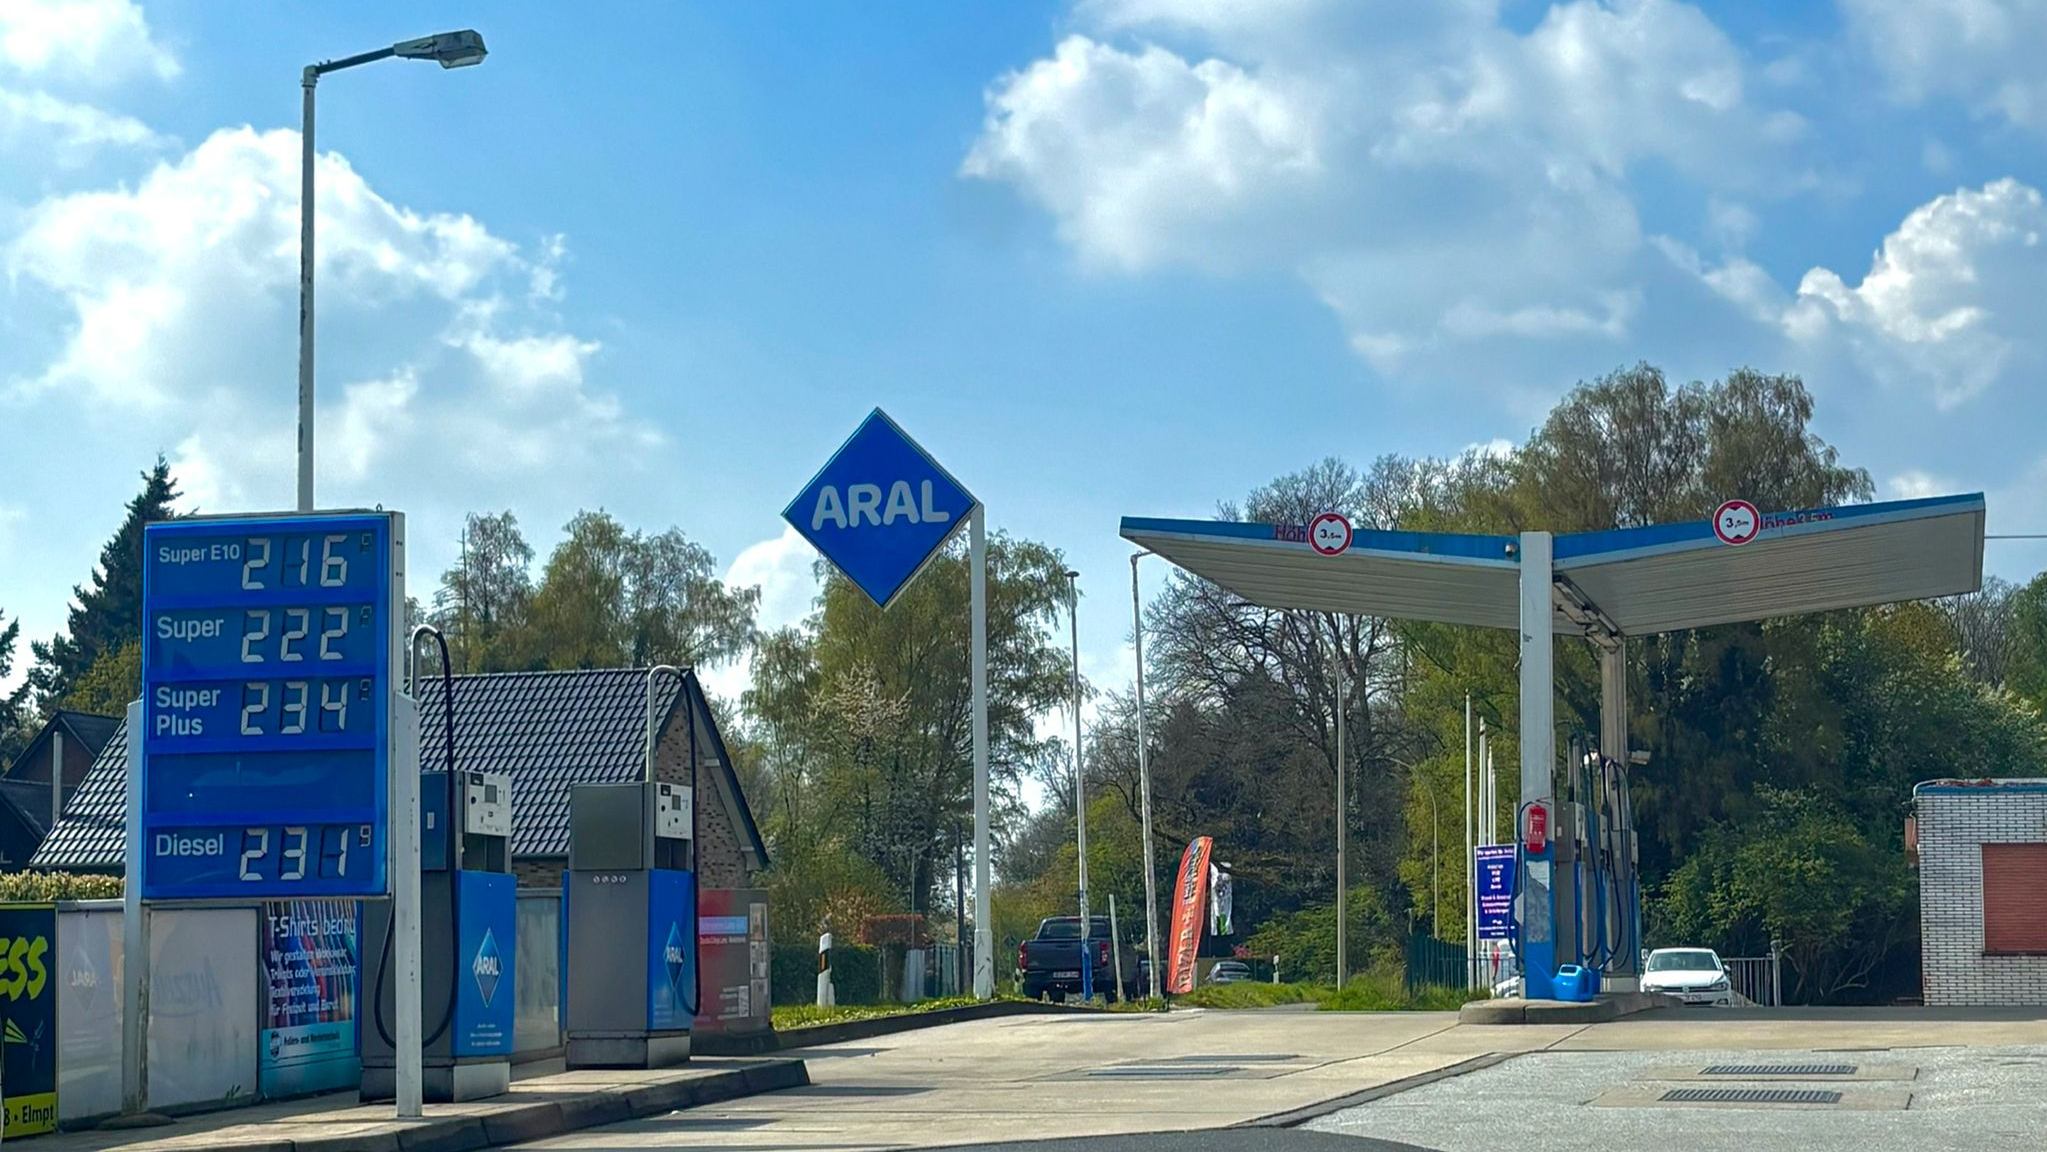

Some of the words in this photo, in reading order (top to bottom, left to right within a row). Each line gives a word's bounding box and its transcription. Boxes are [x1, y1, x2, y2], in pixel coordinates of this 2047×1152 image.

[811, 479, 950, 531] ARAL
[159, 546, 207, 565] Super
[211, 544, 240, 560] E10
[242, 535, 347, 590] 216
[157, 616, 224, 642] Super
[241, 607, 349, 663] 222
[156, 686, 221, 711] Super
[240, 681, 349, 735] 234
[156, 714, 203, 736] Plus
[156, 833, 224, 857] Diesel
[239, 826, 348, 881] 231
[268, 915, 318, 938] T-Shirts
[476, 956, 499, 976] ARAL
[22, 1103, 54, 1127] Elmpt
